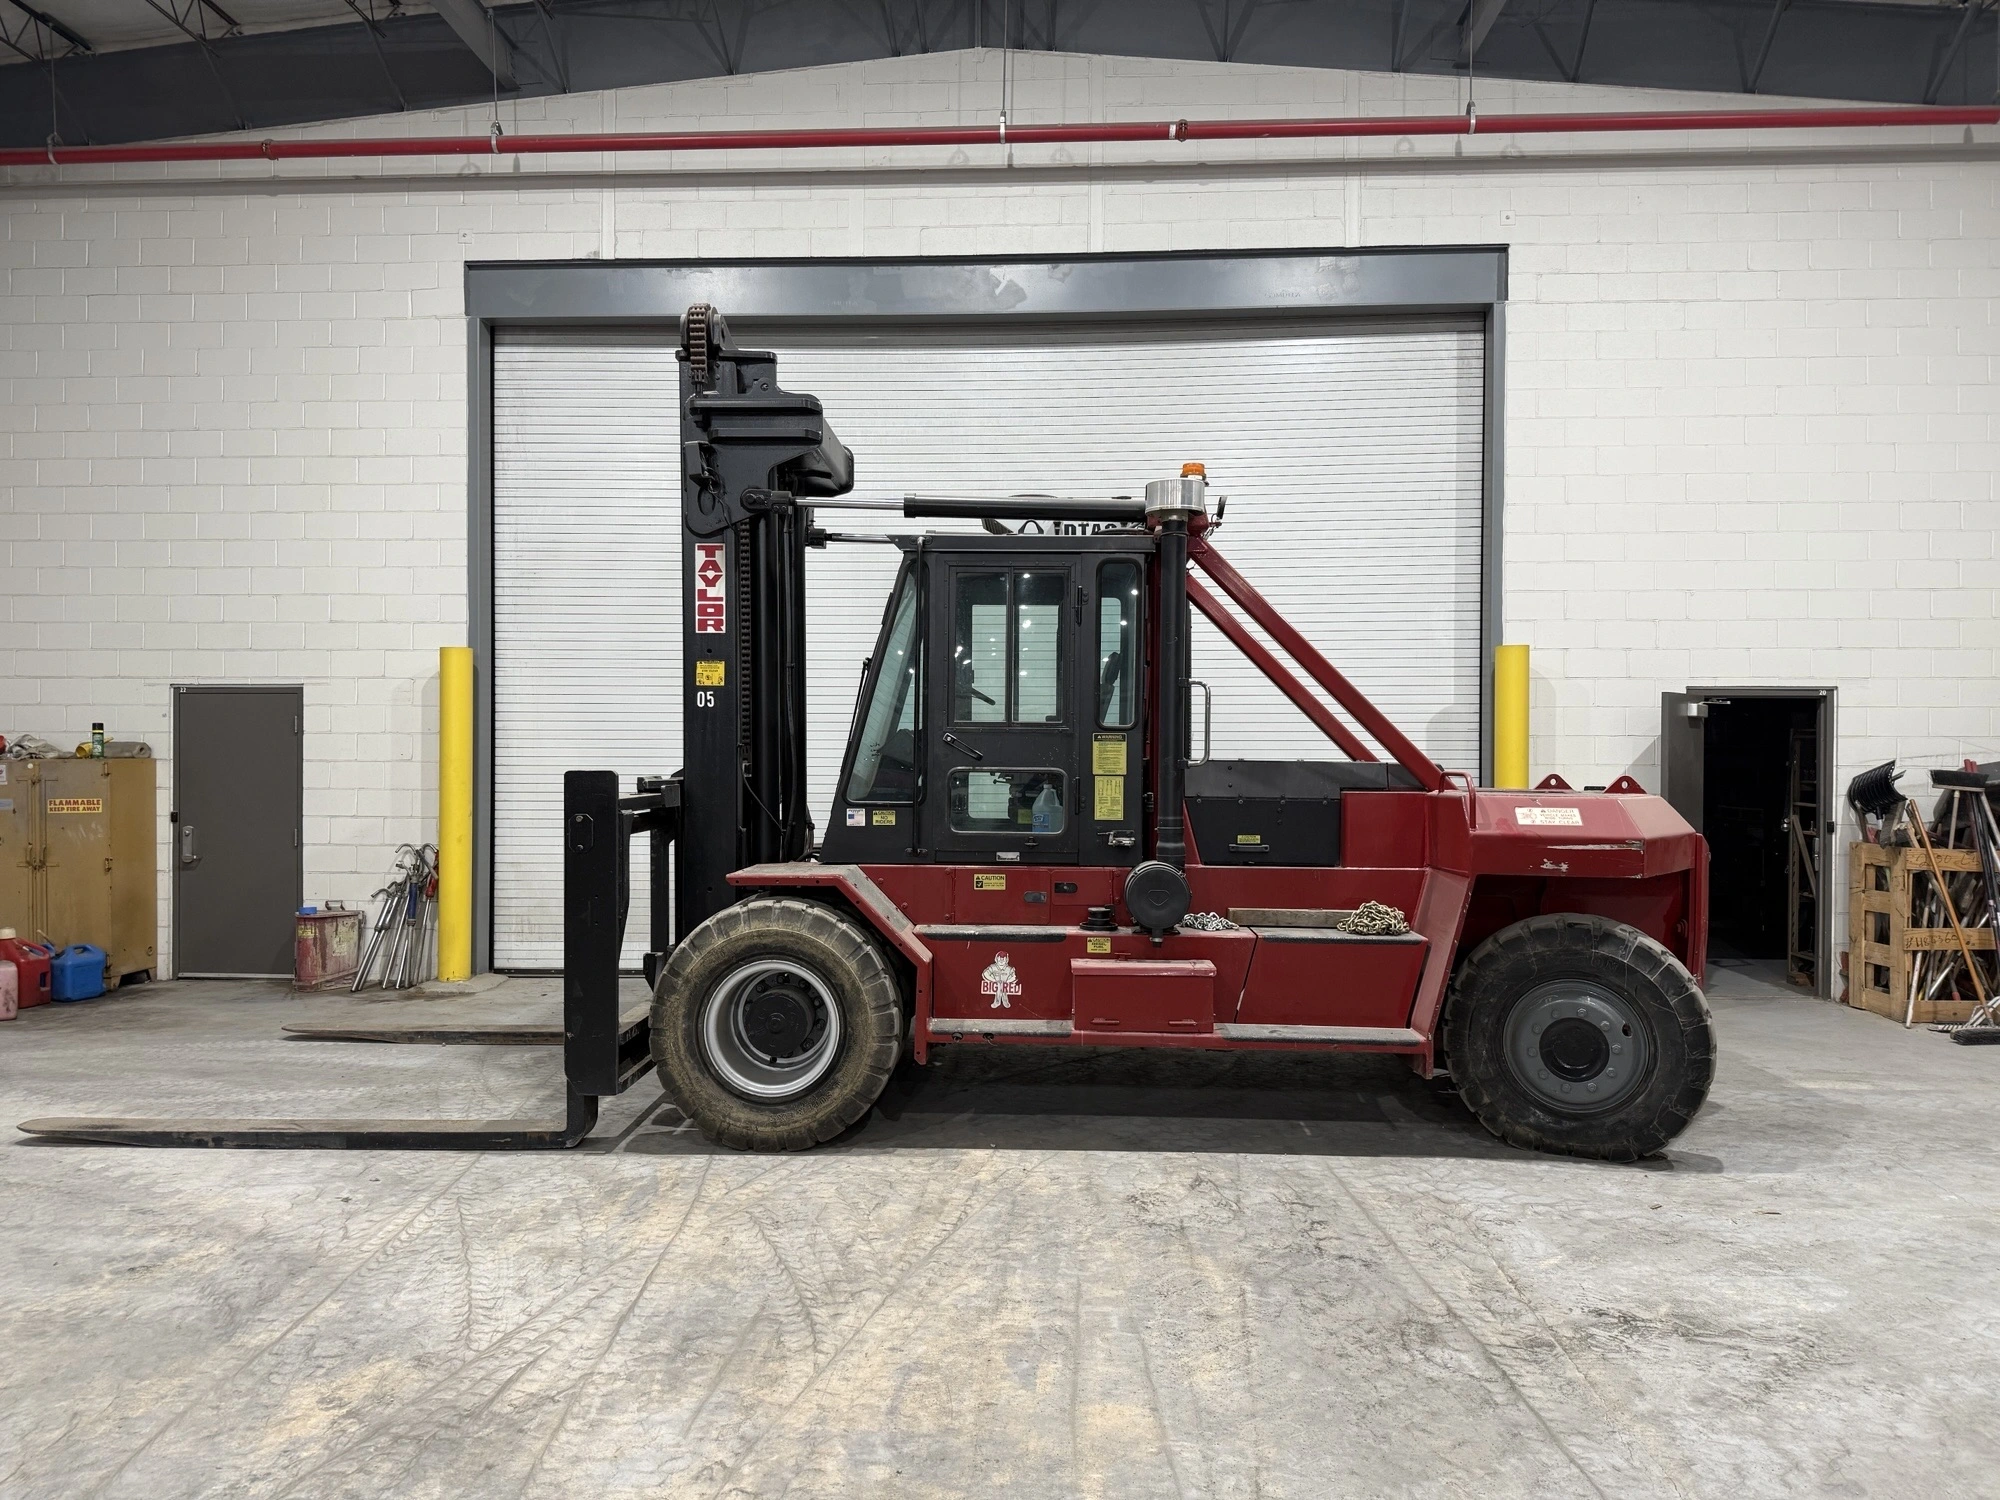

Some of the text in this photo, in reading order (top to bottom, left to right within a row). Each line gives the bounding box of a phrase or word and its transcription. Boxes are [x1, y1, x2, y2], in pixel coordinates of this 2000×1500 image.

[697, 544, 724, 632] TAYLOR
[697, 692, 714, 707] 05
[982, 982, 1020, 993] BIG RED
